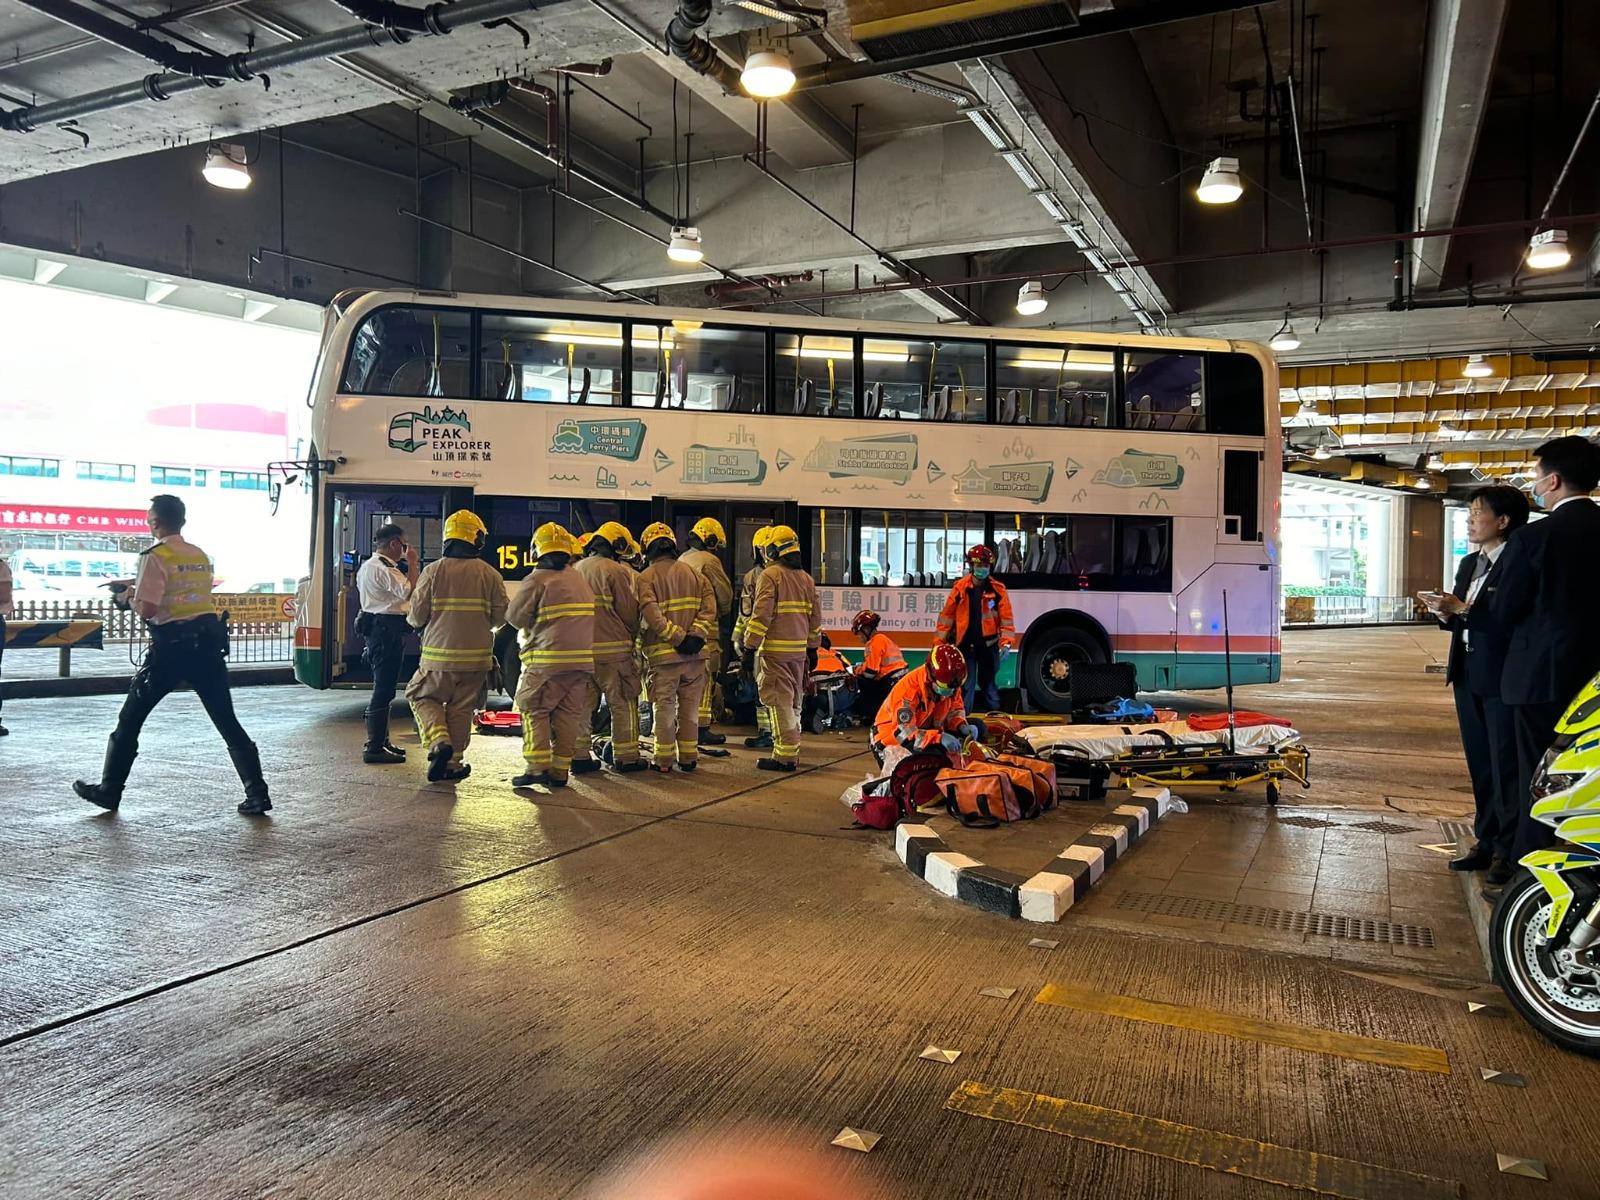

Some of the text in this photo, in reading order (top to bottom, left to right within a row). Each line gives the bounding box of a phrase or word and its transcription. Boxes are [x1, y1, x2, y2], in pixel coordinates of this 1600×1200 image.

[422, 428, 462, 439] PEAK
[433, 441, 491, 450] EXPLORER
[590, 444, 608, 452] Ferry
[862, 461, 880, 469] Road
[880, 462, 908, 470] Lookout
[727, 468, 750, 476] House
[76, 516, 110, 526] CMB
[496, 545, 518, 569] 15
[820, 617, 836, 626] eel
[840, 616, 854, 626] th
[910, 618, 921, 627] of
[923, 618, 936, 628] Th
